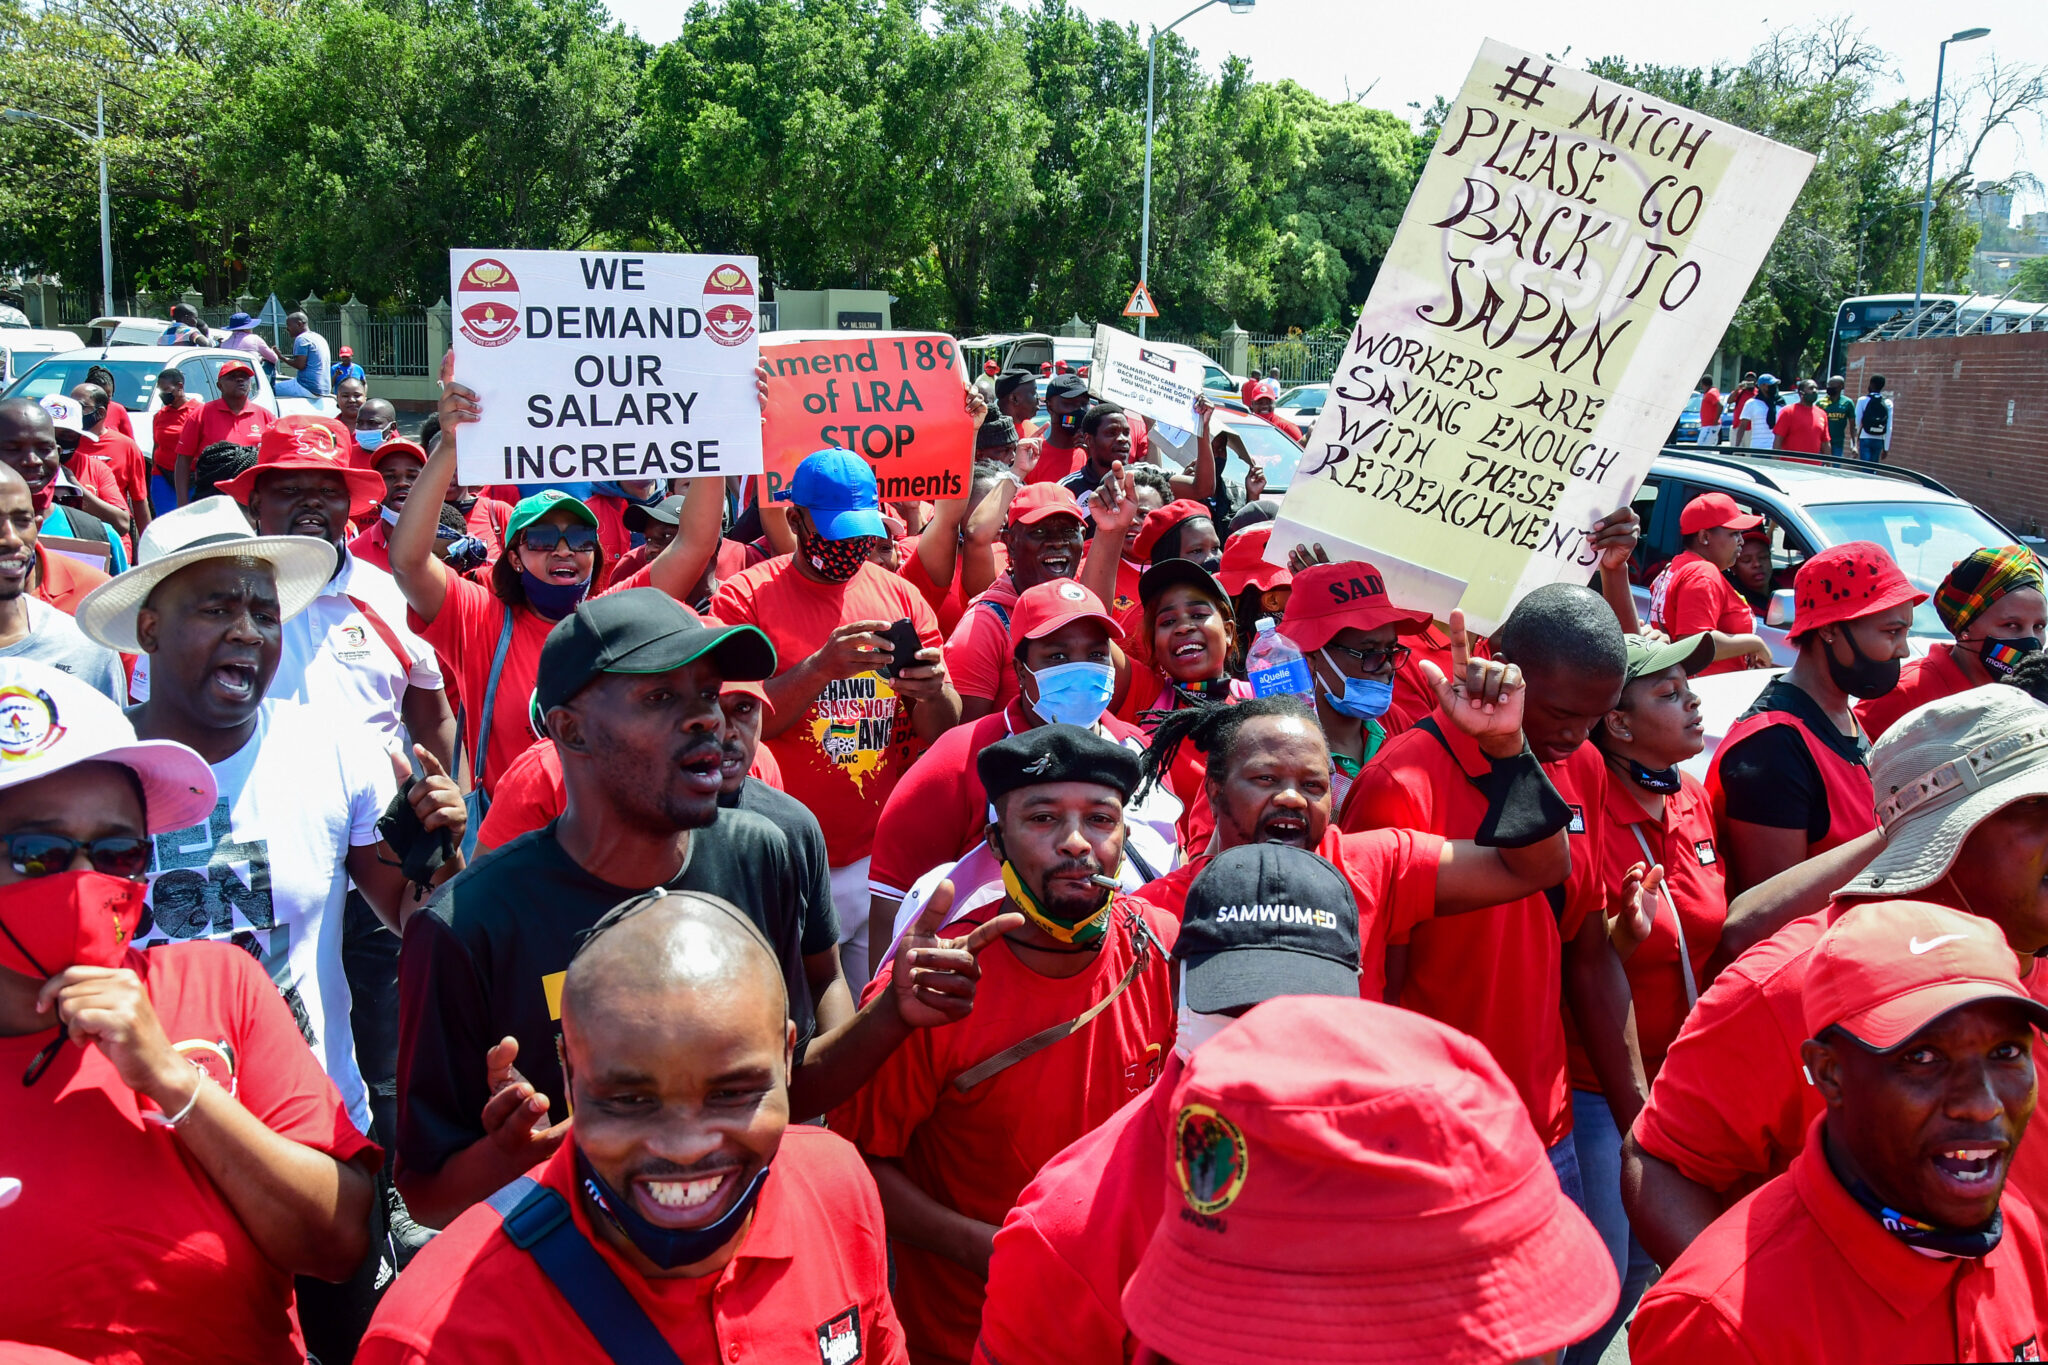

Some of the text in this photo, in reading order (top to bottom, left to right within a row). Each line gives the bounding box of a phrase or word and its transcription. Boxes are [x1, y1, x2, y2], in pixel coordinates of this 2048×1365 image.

[1493, 56, 1555, 110] #
[1442, 106, 1703, 236] PLEASE GO
[1429, 177, 1701, 311] BACK TO
[580, 258, 645, 290] WE
[525, 306, 701, 339] DEMAND
[1416, 251, 1632, 386] JAPAN
[574, 355, 664, 388] OUR
[893, 340, 956, 371] 189
[802, 378, 924, 414] of LRA
[1354, 323, 1605, 433] WORKERS ARE
[526, 392, 698, 428] SALARY
[820, 424, 915, 459] STOP
[1477, 413, 1620, 484] ENOUGH
[503, 440, 721, 480] INCREASE
[1459, 451, 1566, 512] THESE
[1307, 443, 1599, 566] RETRENCHMENTS
[1259, 667, 1290, 684] aQuellé
[1985, 657, 2014, 674] makro
[818, 698, 860, 720] SAYS
[858, 717, 893, 751] ANC
[838, 754, 859, 765] ANC
